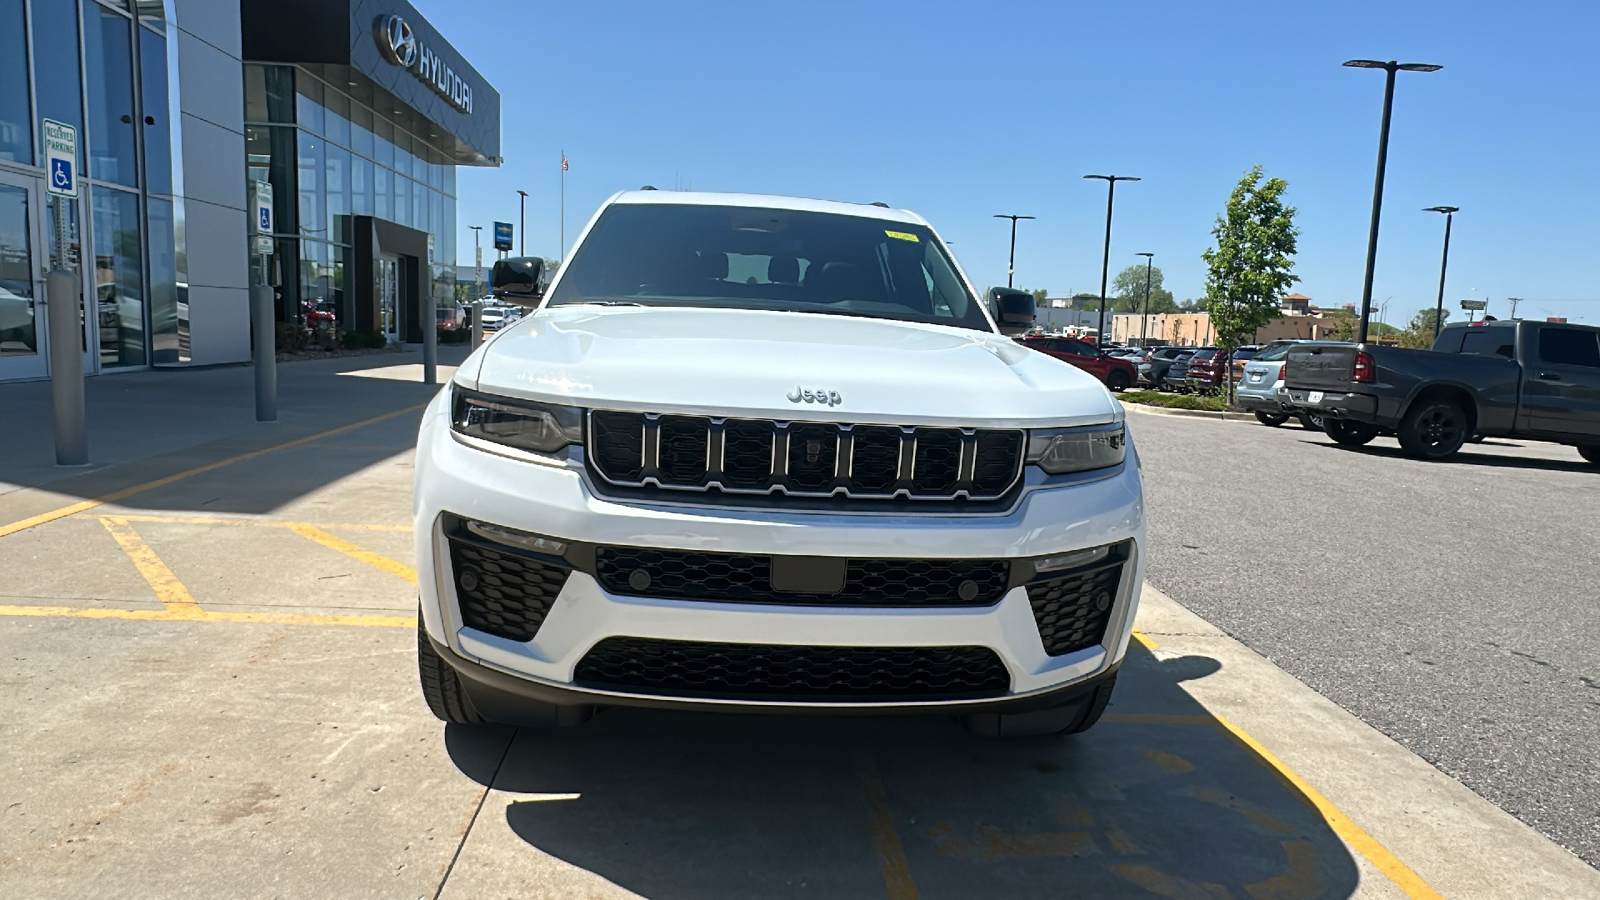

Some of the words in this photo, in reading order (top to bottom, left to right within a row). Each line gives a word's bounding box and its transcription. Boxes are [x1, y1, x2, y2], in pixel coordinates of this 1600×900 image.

[419, 42, 473, 114] HYUNDAI
[46, 126, 74, 143] RESERVED
[47, 140, 75, 155] PARKING
[786, 385, 842, 407] Jeep
